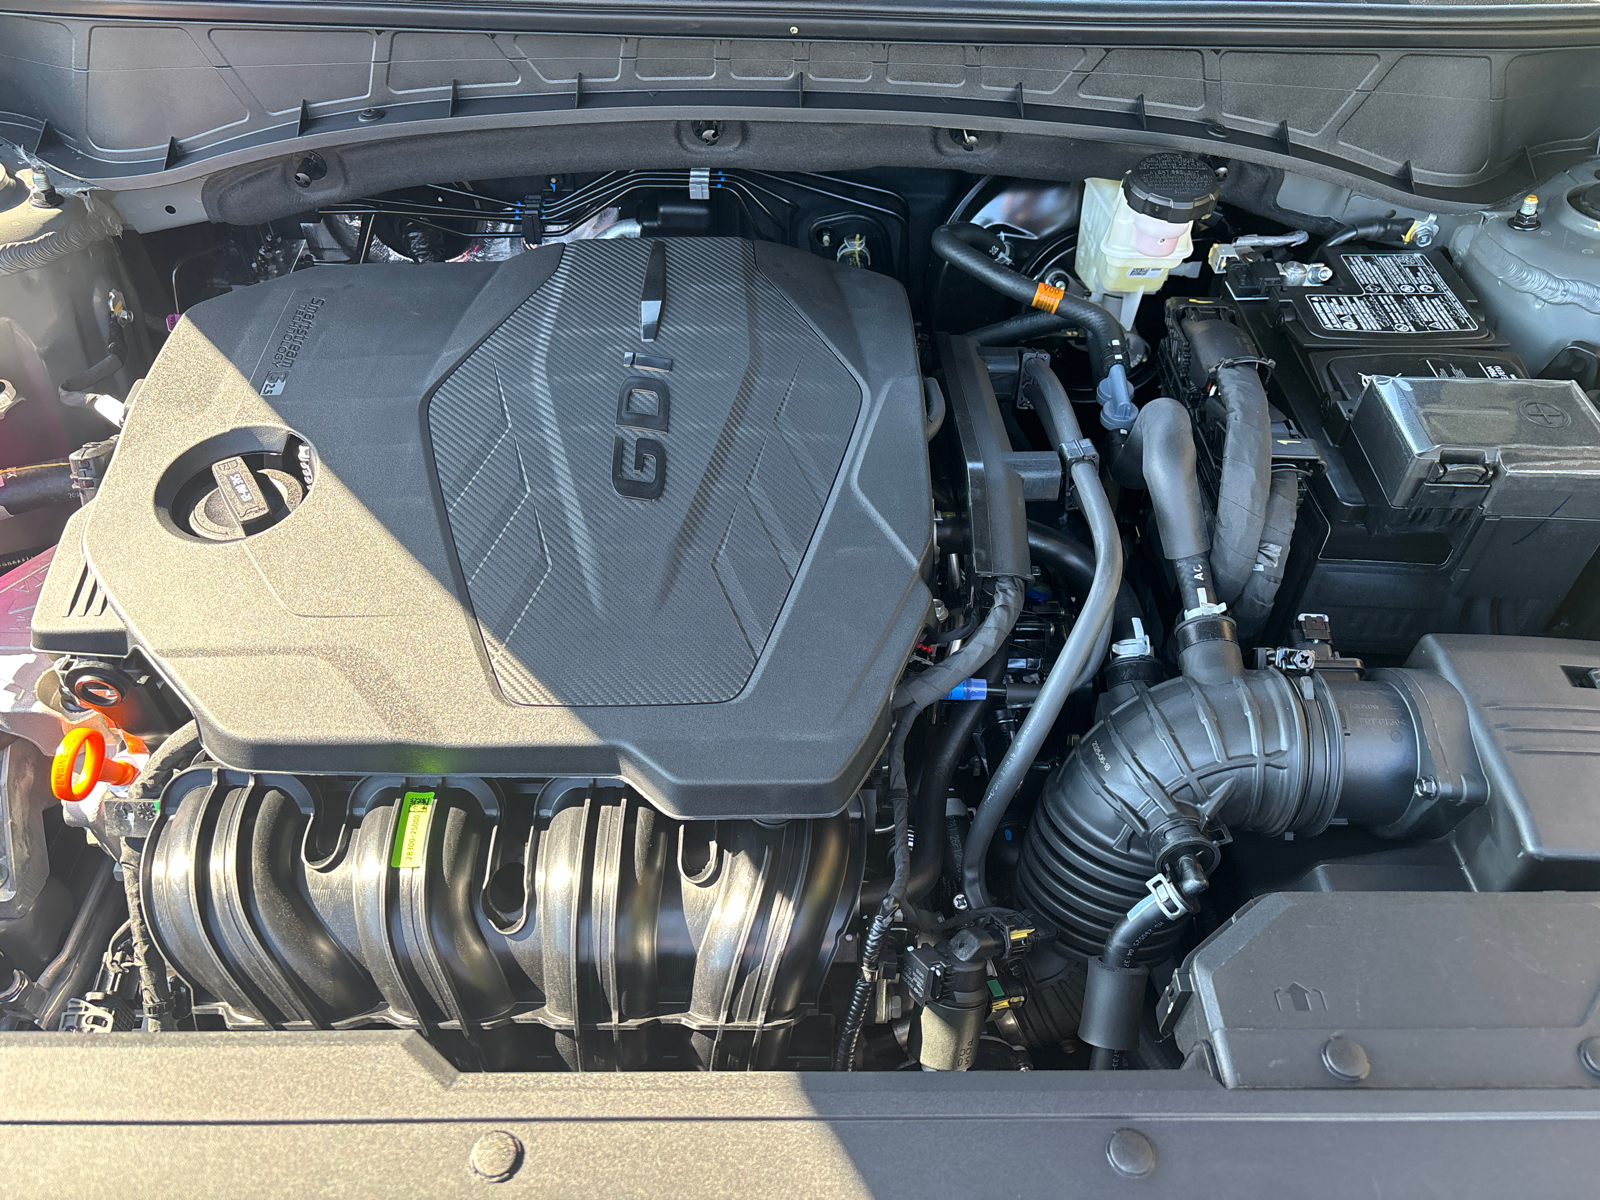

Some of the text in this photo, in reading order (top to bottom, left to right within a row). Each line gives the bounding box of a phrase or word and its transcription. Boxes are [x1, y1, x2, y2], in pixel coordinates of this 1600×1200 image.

[271, 304, 307, 368] TECHNOLOGY
[281, 296, 325, 369] Smartstream
[230, 473, 243, 486] SAE
[56, 754, 69, 787] ENGINE
[406, 814, 421, 861] 28300-25000
